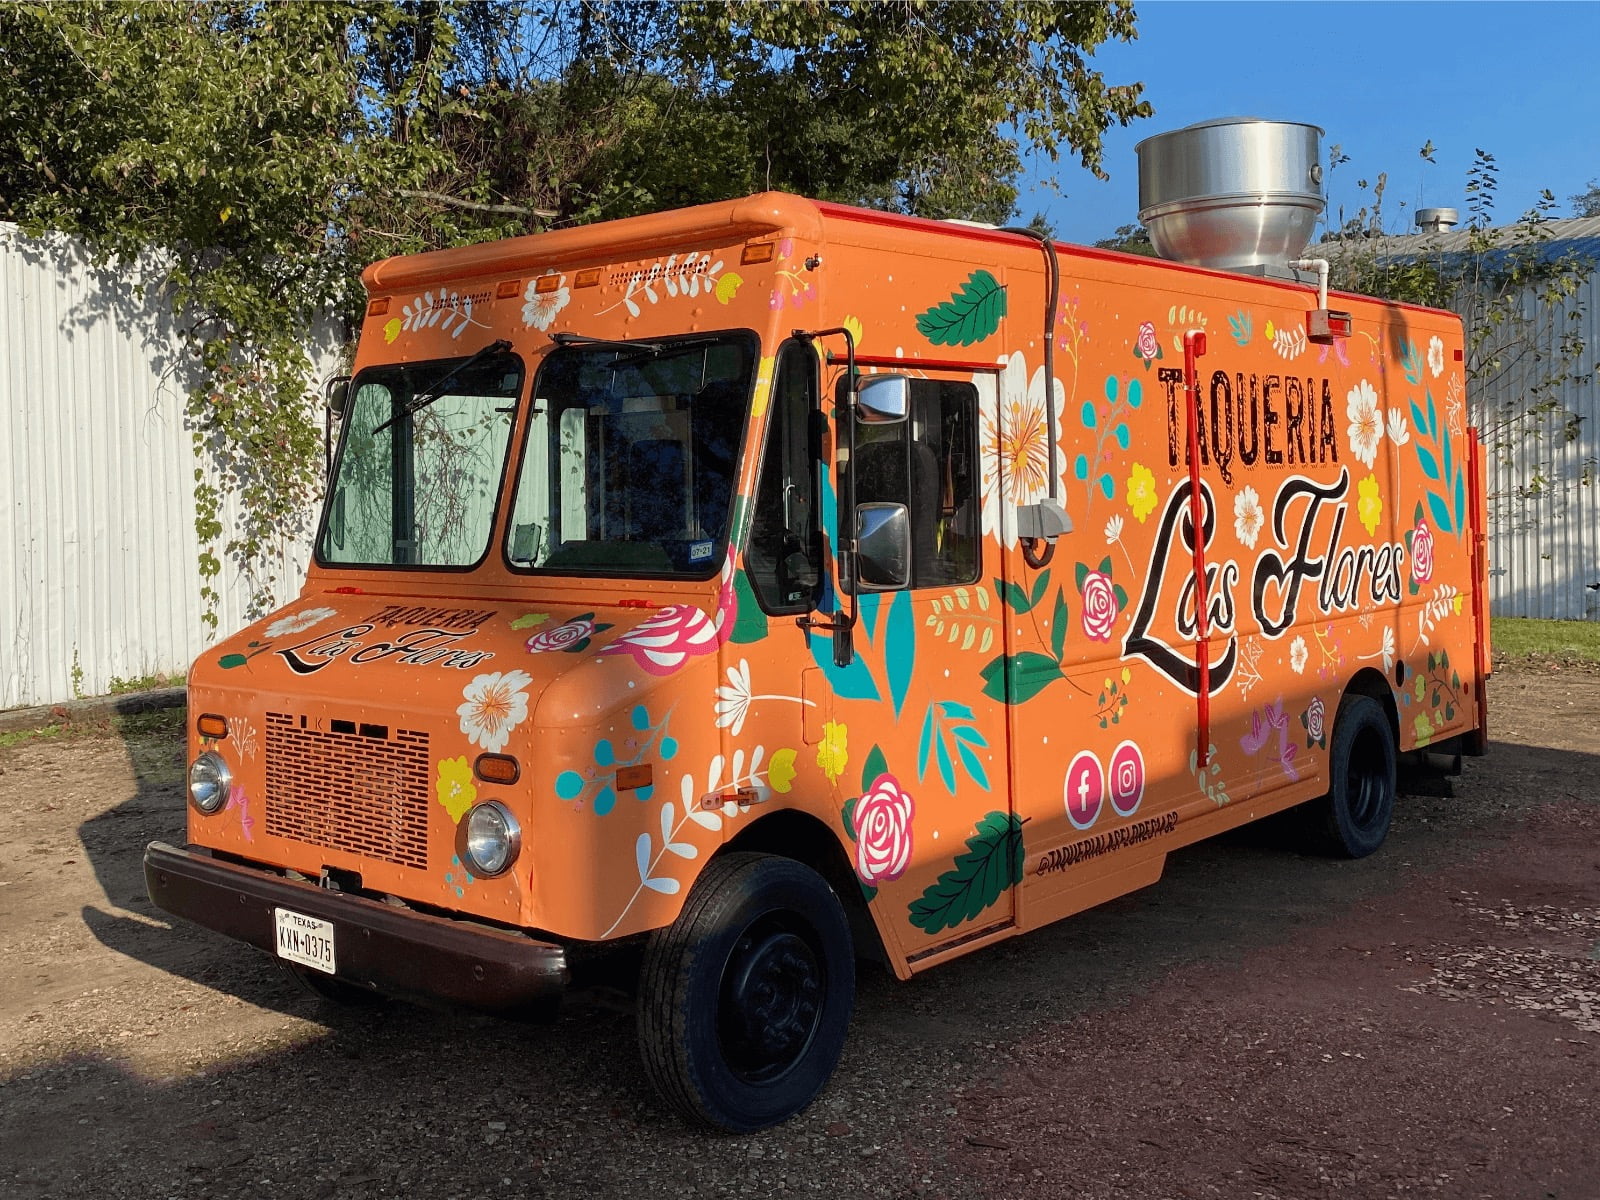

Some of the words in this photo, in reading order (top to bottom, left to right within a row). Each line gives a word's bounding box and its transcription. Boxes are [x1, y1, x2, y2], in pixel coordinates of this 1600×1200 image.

[1121, 477, 1238, 696] Las
[1253, 465, 1403, 638] Flores
[362, 605, 498, 628] TAQUERIA
[274, 624, 375, 675] Las
[350, 629, 496, 669] Flores
[292, 915, 316, 930] TEXAS
